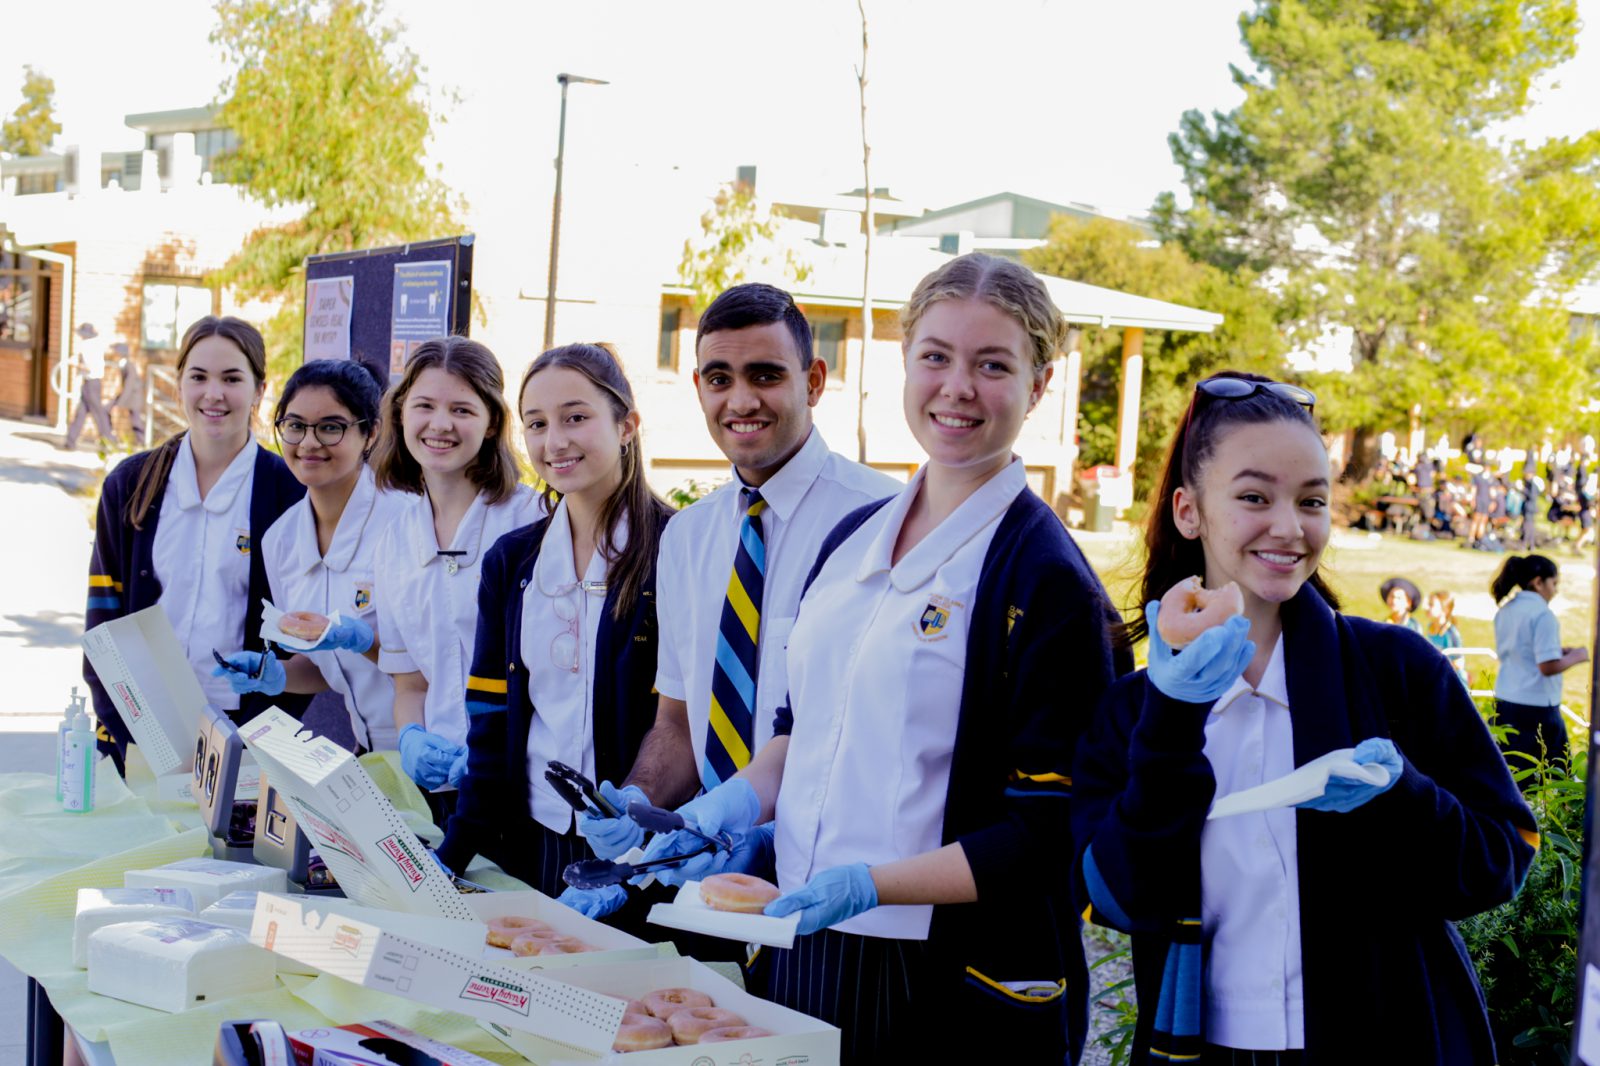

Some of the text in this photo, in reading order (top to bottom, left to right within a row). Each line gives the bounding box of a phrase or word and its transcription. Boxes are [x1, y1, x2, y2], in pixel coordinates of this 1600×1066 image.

[383, 838, 422, 883] Krispy Kreme
[466, 982, 528, 1009] Krispy Kreme
